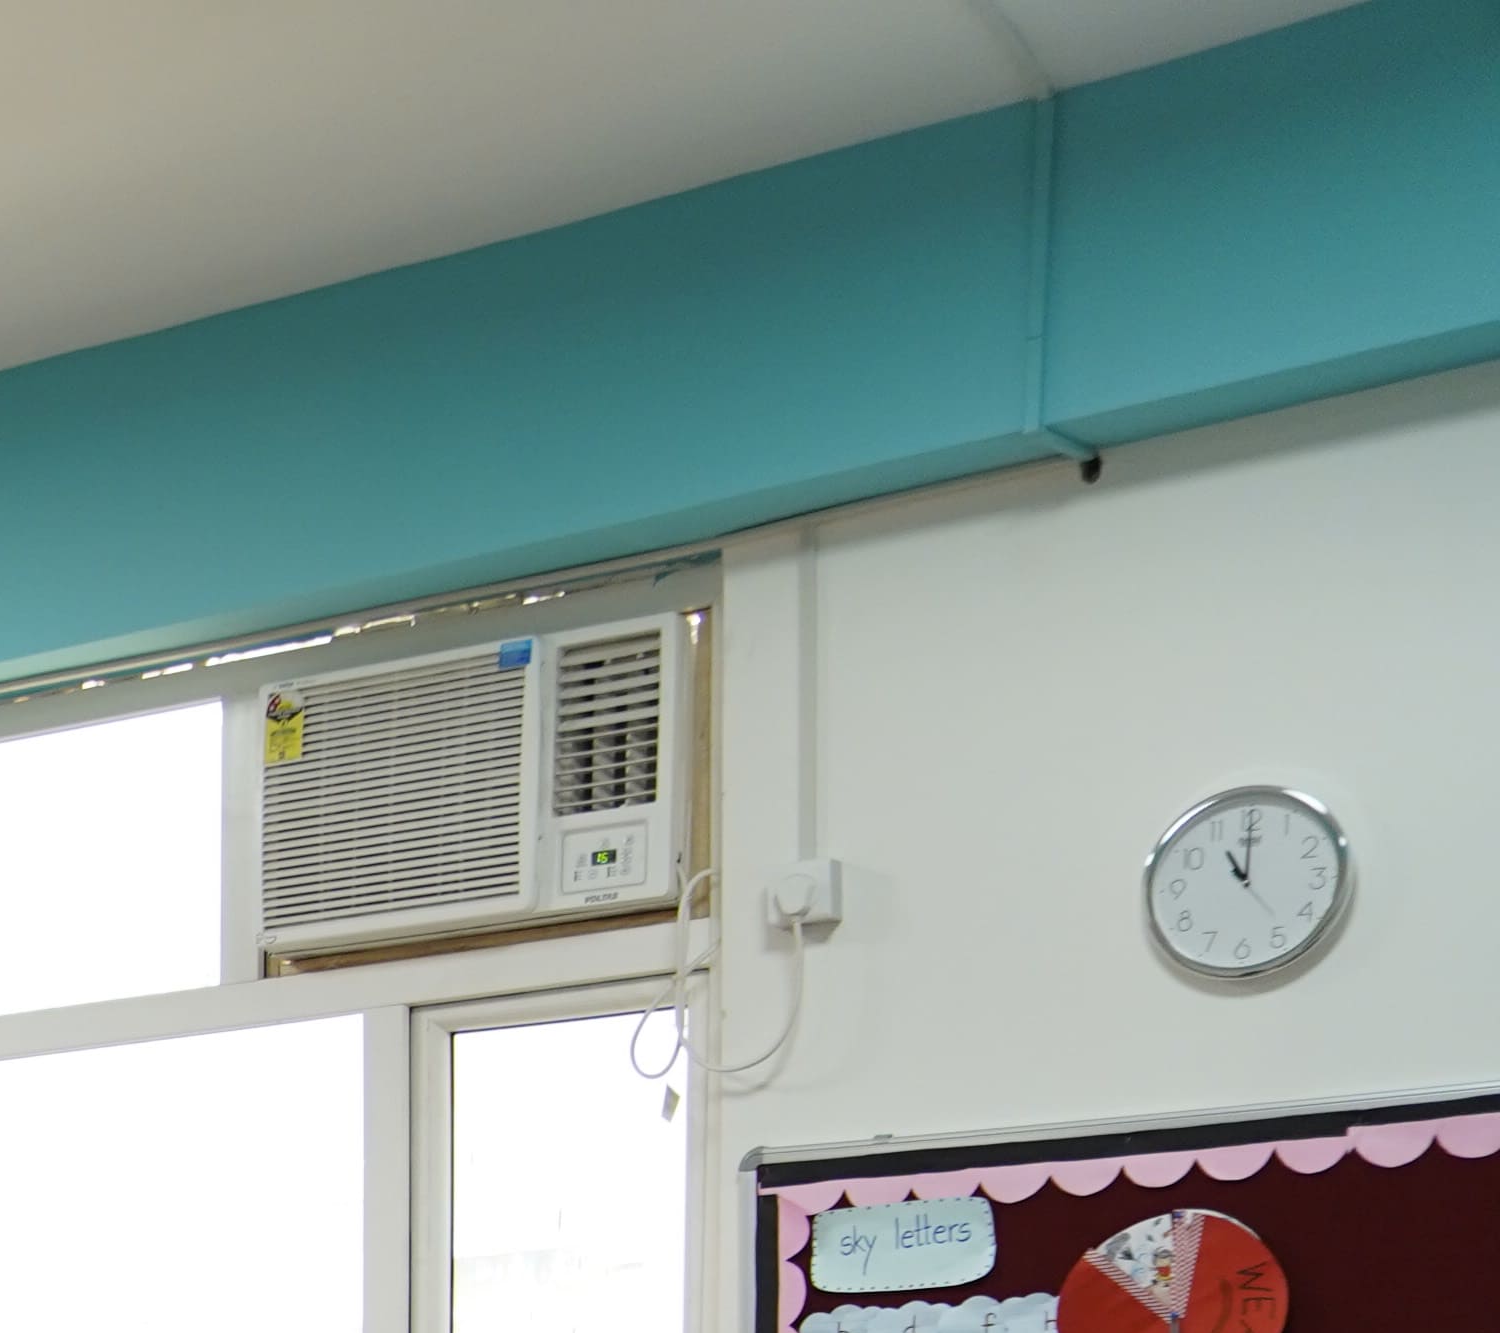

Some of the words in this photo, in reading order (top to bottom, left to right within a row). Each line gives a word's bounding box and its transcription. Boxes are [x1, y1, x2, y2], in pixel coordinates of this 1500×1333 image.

[1301, 835, 1319, 859] 2
[1183, 847, 1204, 871] 10
[1169, 878, 1187, 901] 9
[1308, 867, 1327, 890] 3
[1177, 910, 1194, 932] 8
[1296, 901, 1314, 923] 4
[1200, 931, 1218, 957] 7
[1233, 938, 1251, 960] 6
[1269, 926, 1287, 949] 5
[839, 1225, 877, 1276] sky
[895, 1213, 972, 1250] letters
